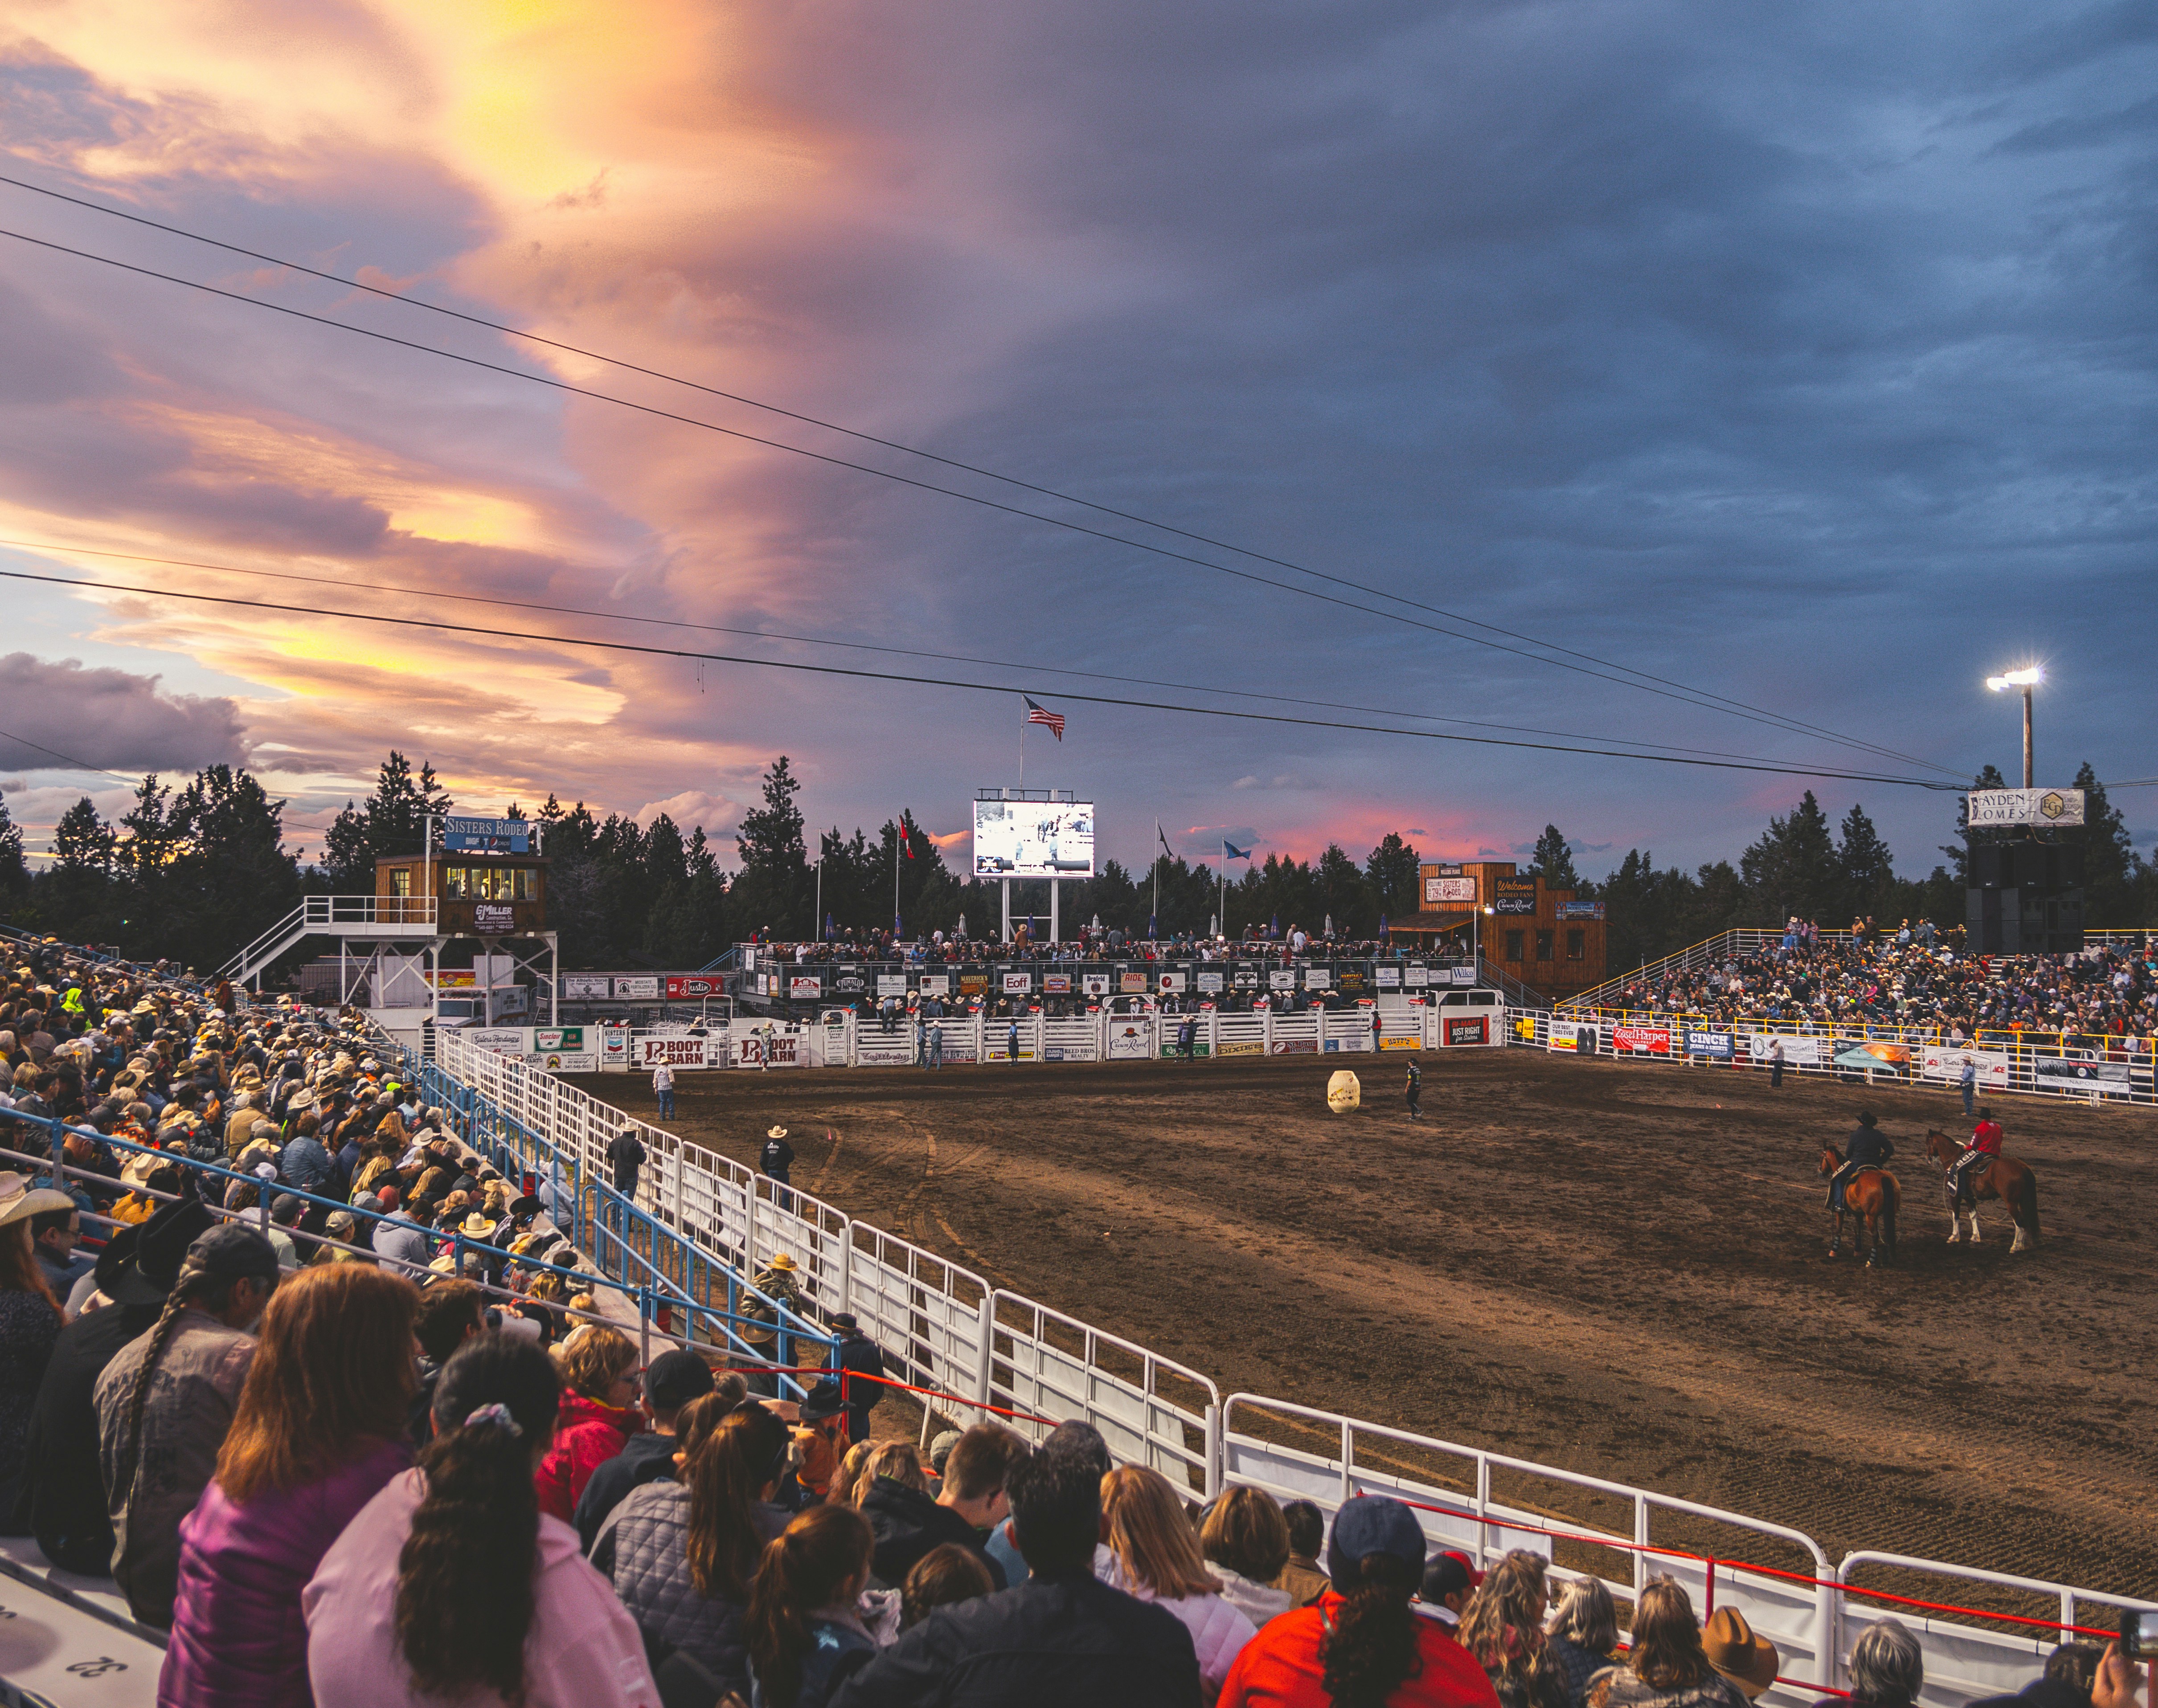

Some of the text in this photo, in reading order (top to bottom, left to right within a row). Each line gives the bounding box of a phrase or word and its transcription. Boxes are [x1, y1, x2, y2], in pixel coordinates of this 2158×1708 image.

[447, 817, 528, 836] SISTERS RODEO
[1498, 880, 1534, 891] Welcome
[1432, 888, 1438, 898] 79
[1497, 899, 1534, 912] Crown Royal
[1453, 968, 1473, 978] Wilco
[680, 980, 708, 996] Justin
[840, 979, 860, 988] TUMALO
[1007, 977, 1028, 988] Eoff
[1452, 1019, 1481, 1028] BI-MART
[1452, 1026, 1480, 1036] JUST RIGHT
[474, 1034, 520, 1045] Sisters Hardware
[772, 1039, 795, 1050] OOT
[1689, 1033, 1728, 1045] CINCH
[667, 1041, 703, 1052] BOOT
[1110, 1039, 1148, 1051] Crown Royal
[1219, 1043, 1262, 1054] DIXIE'S
[667, 1053, 703, 1064] BARN
[770, 1050, 796, 1062] ARN
